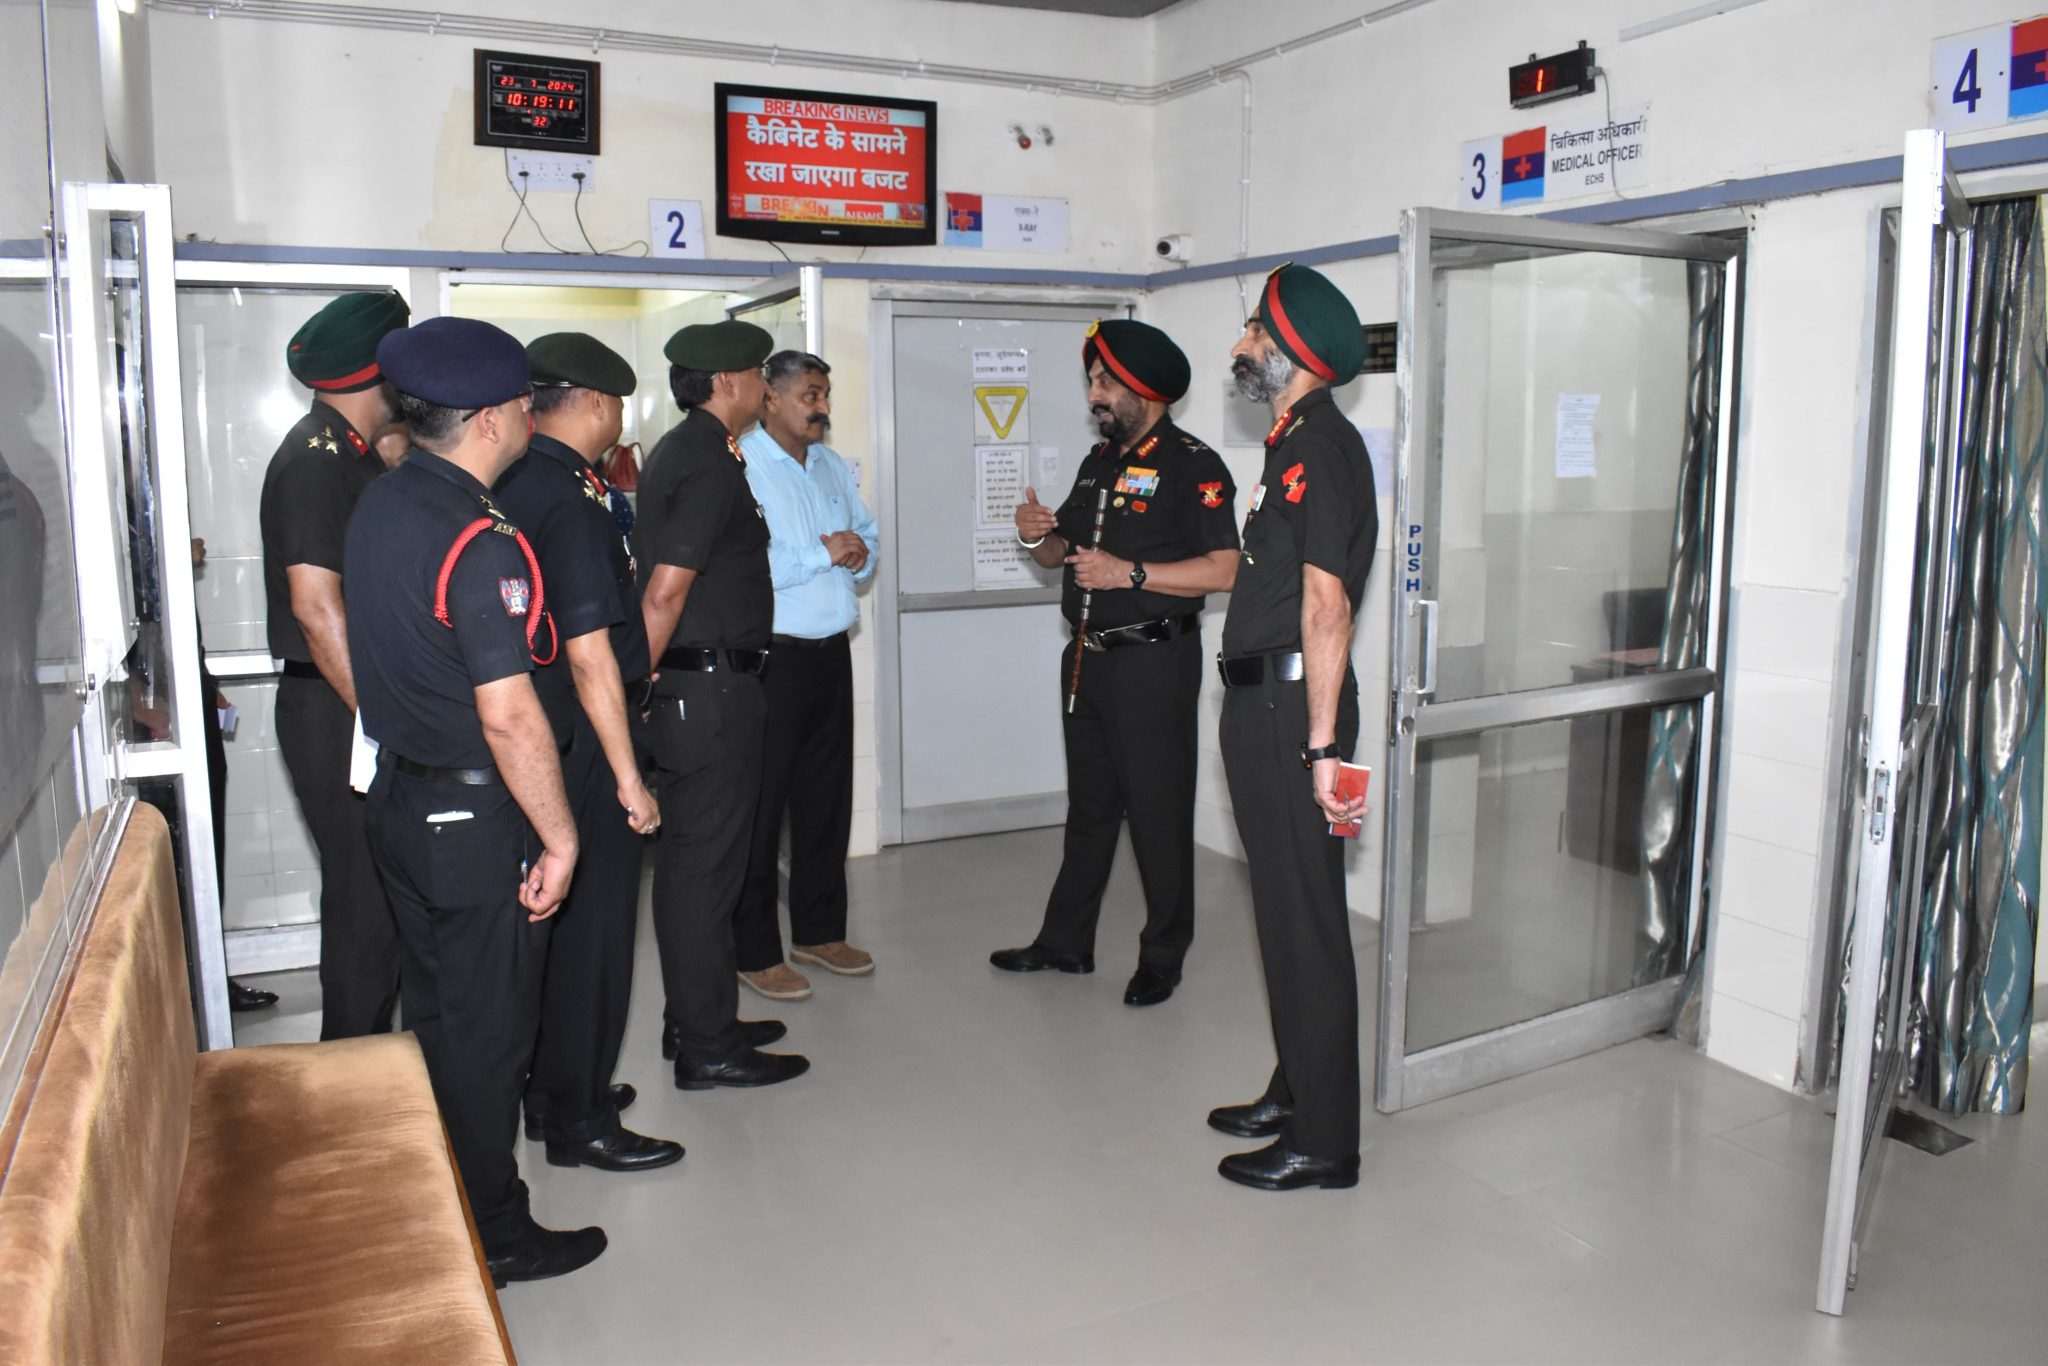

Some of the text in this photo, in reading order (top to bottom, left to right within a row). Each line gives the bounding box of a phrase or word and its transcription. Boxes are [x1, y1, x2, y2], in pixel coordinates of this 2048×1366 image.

[501, 76, 575, 92] 23 7 2024
[1536, 69, 1544, 92] 1
[1952, 48, 1981, 113] 4
[533, 116, 547, 127] 32
[764, 98, 888, 124] BREAKING NEWS
[746, 115, 907, 155] कैबिनेट के सामने
[1550, 129, 1595, 151] चिकित्सा
[1552, 143, 1643, 173] MEDICAL OFFICER
[745, 161, 908, 190] रखा जाएगा बजट
[1471, 152, 1486, 200] 3
[1585, 173, 1605, 186] ECHS
[667, 211, 686, 248] 2
[1018, 223, 1038, 233] X-RAY
[1406, 525, 1422, 592] PUSH
